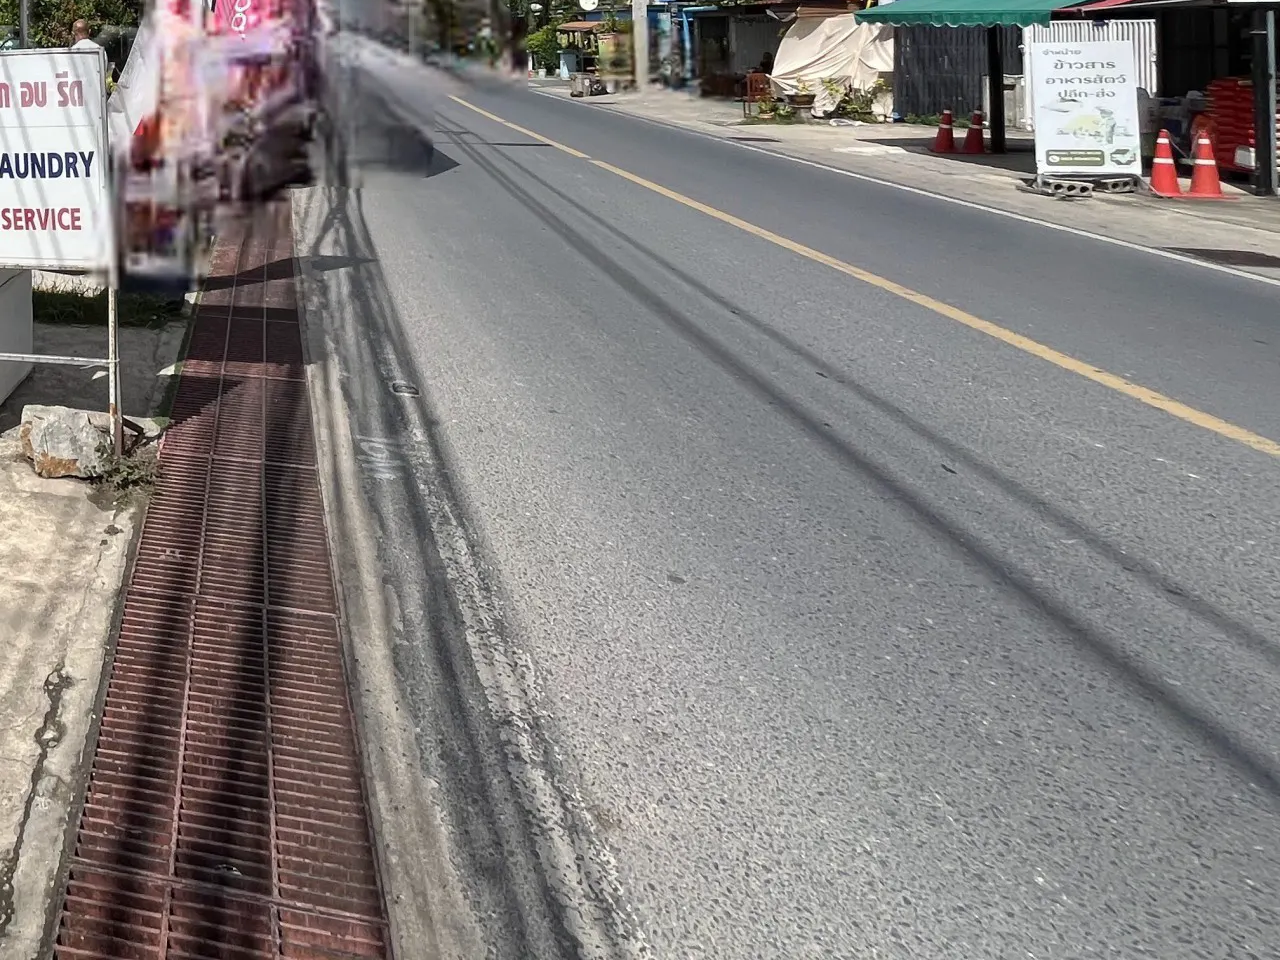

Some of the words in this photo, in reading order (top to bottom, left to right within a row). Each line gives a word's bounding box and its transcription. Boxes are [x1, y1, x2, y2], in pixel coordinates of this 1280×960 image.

[1054, 59, 1116, 70] ข้าวสาร
[1046, 74, 1127, 85] อาหารสัตว์
[20, 81, 47, 108] อบ
[56, 71, 84, 106] รีด
[1, 207, 82, 231] SERVICE
